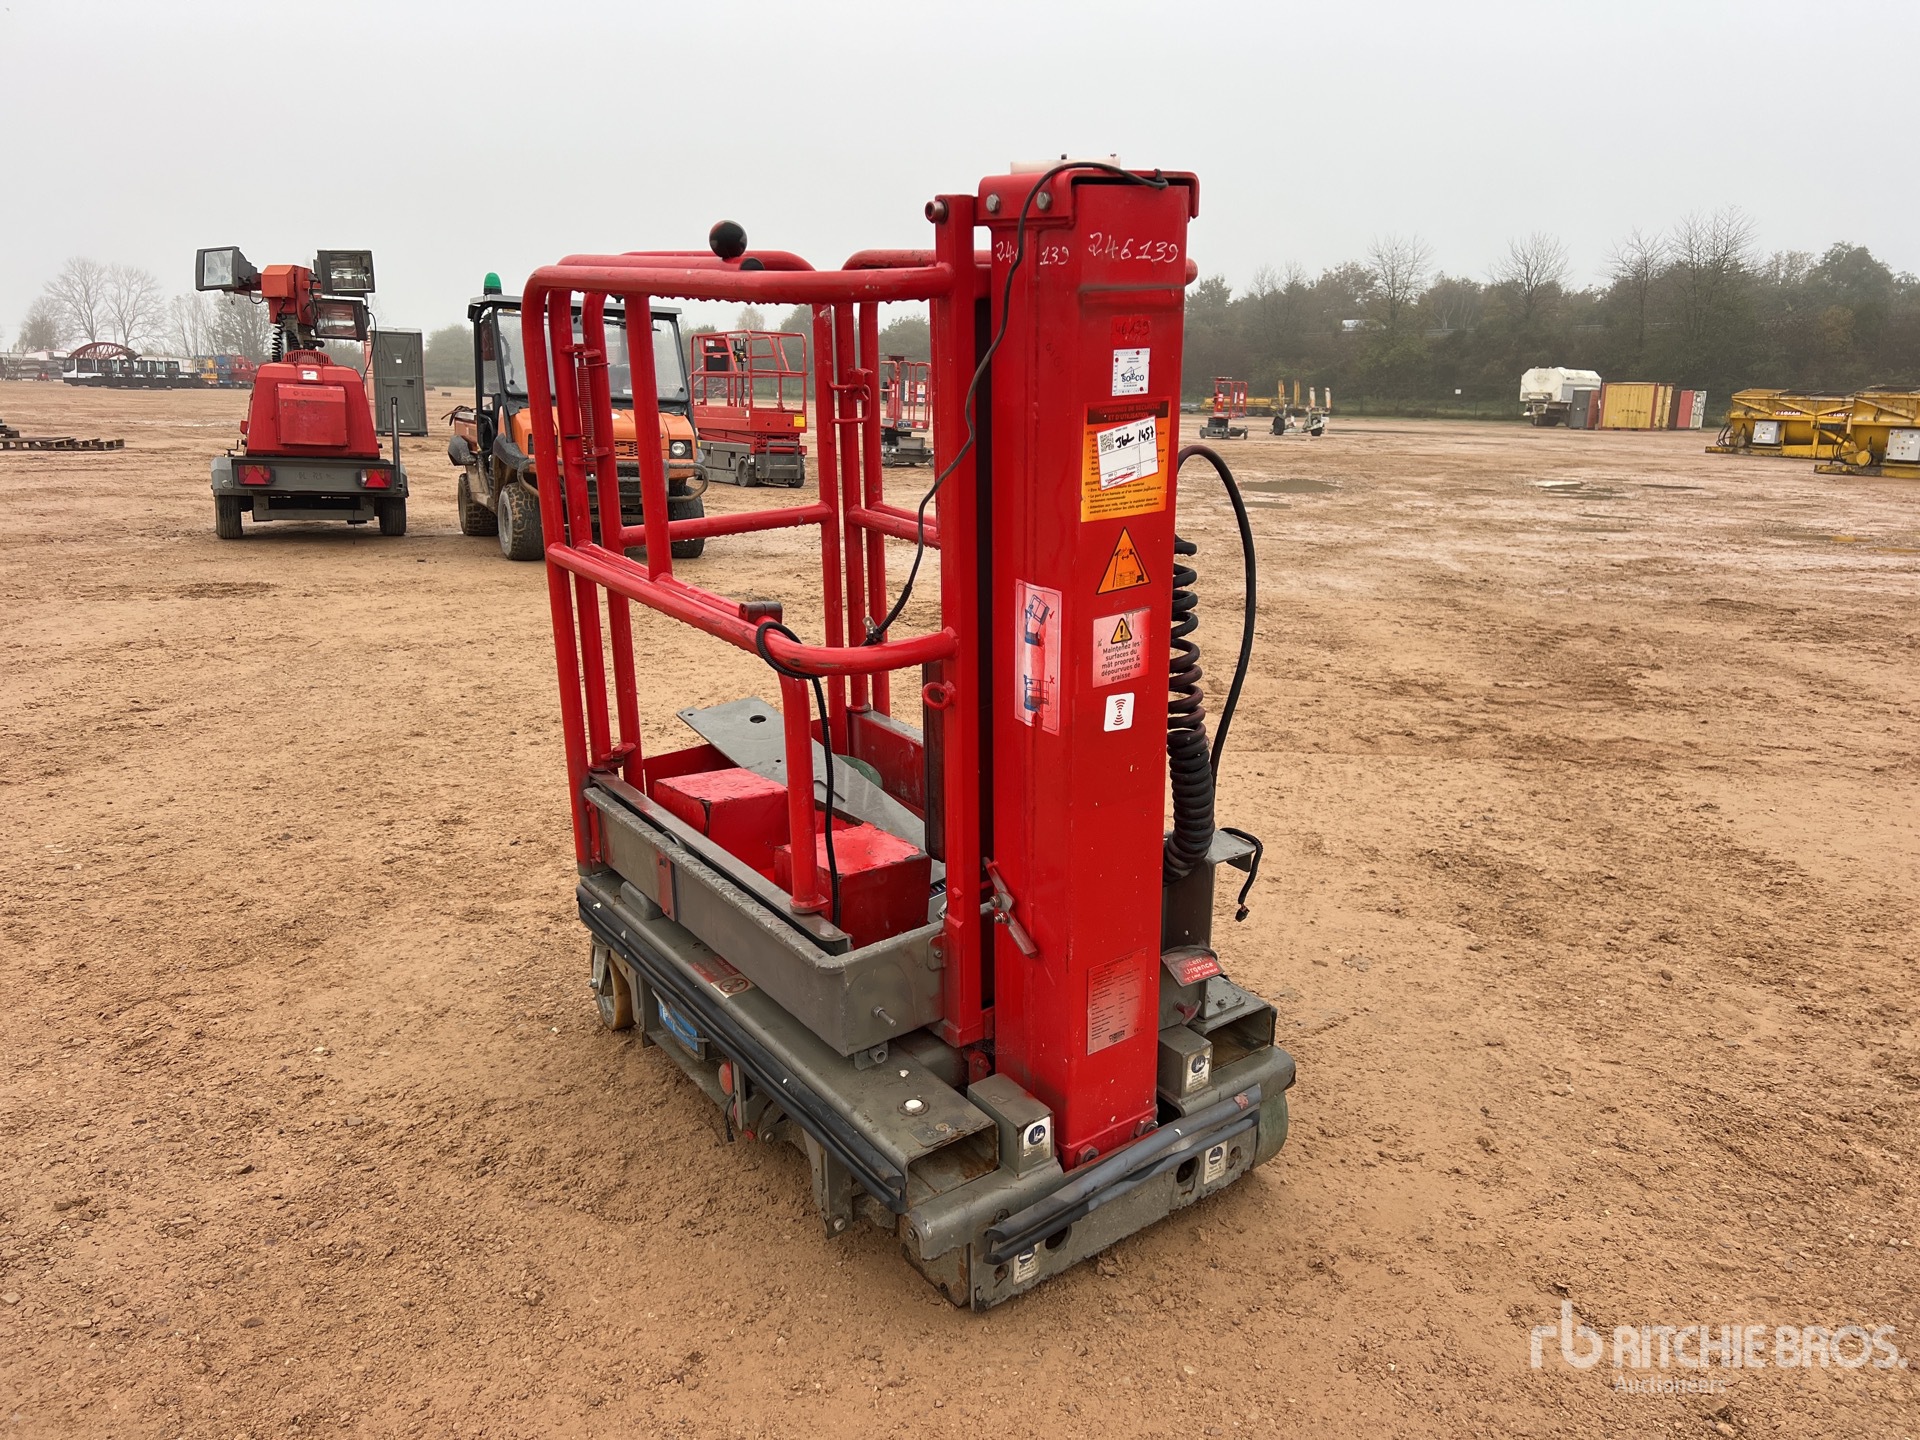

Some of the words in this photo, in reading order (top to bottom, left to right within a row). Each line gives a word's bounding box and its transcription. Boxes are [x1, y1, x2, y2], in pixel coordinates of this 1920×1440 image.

[1088, 232, 1179, 263] 246139
[1039, 246, 1070, 265] 139
[1105, 651, 1129, 661] surfaces
[1114, 656, 1135, 667] propres
[1111, 672, 1131, 682] graisse
[1184, 962, 1214, 975] Urgence
